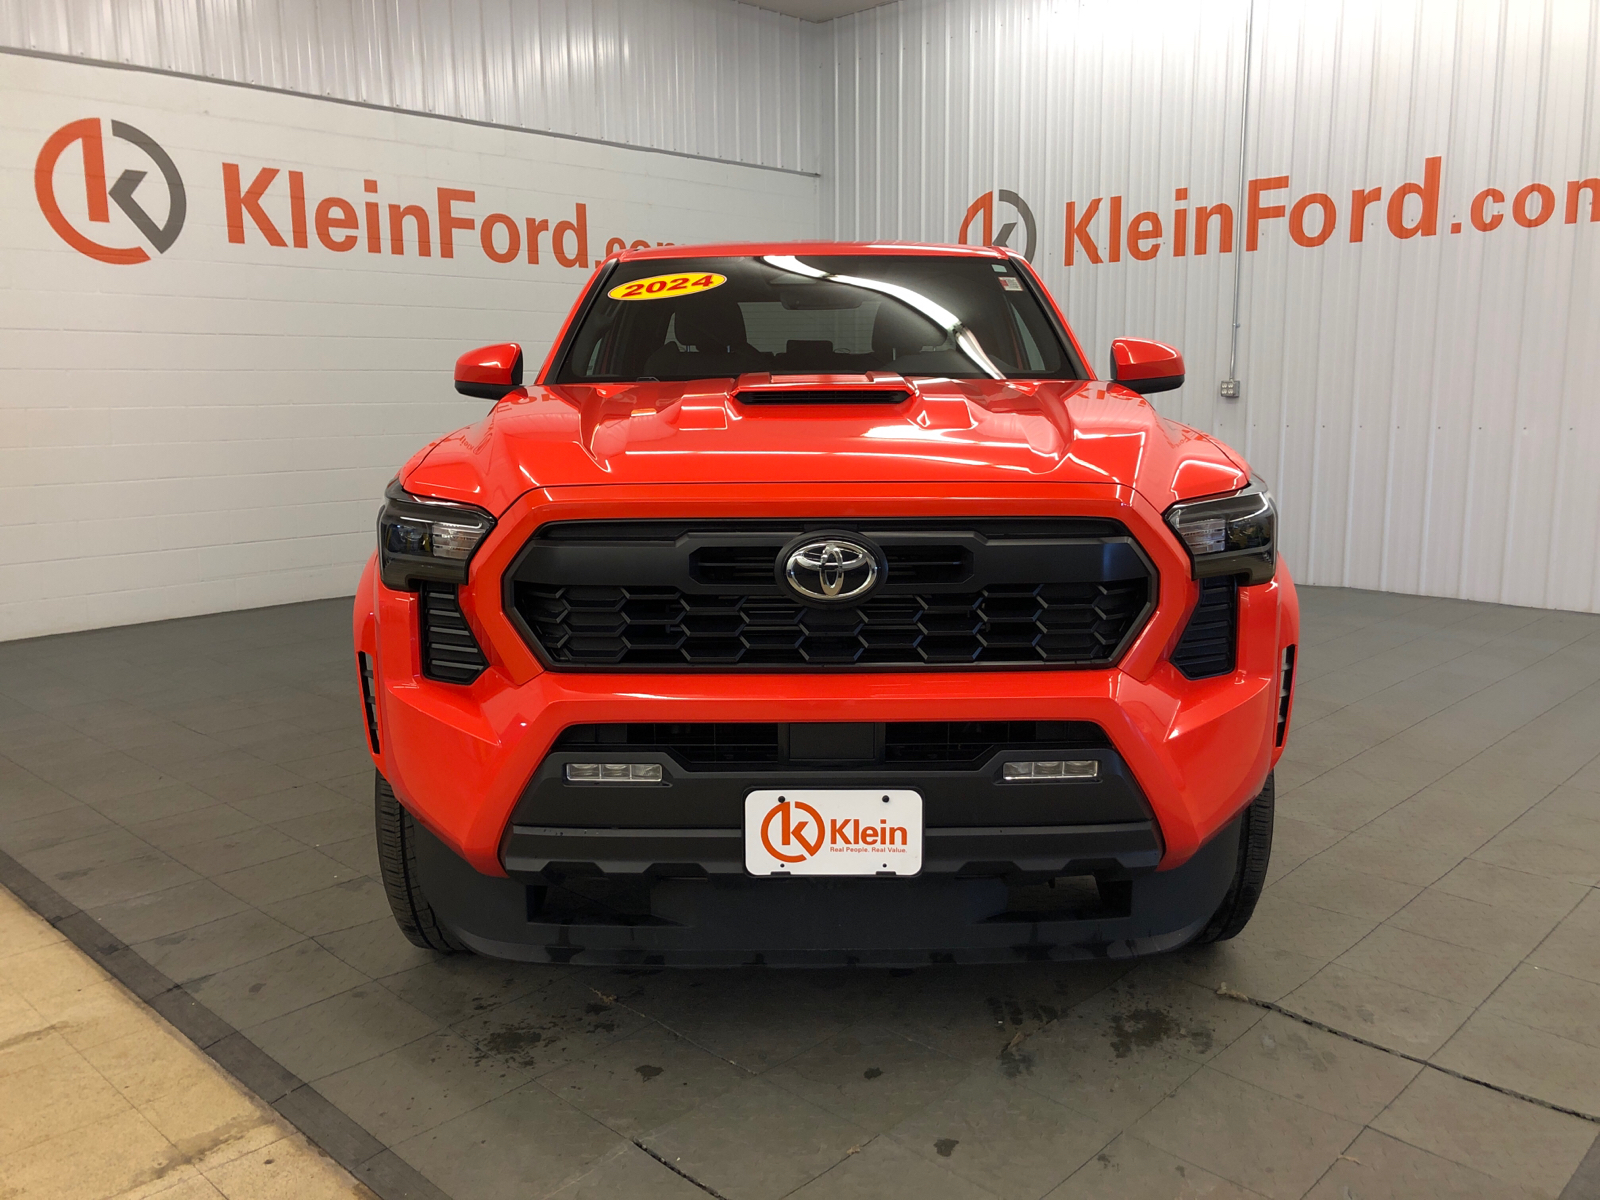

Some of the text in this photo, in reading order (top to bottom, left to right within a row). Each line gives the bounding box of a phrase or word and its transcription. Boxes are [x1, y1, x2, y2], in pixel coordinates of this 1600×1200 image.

[222, 162, 676, 269] KleinFord.
[621, 275, 714, 298] 2024
[830, 819, 907, 845] Klein
